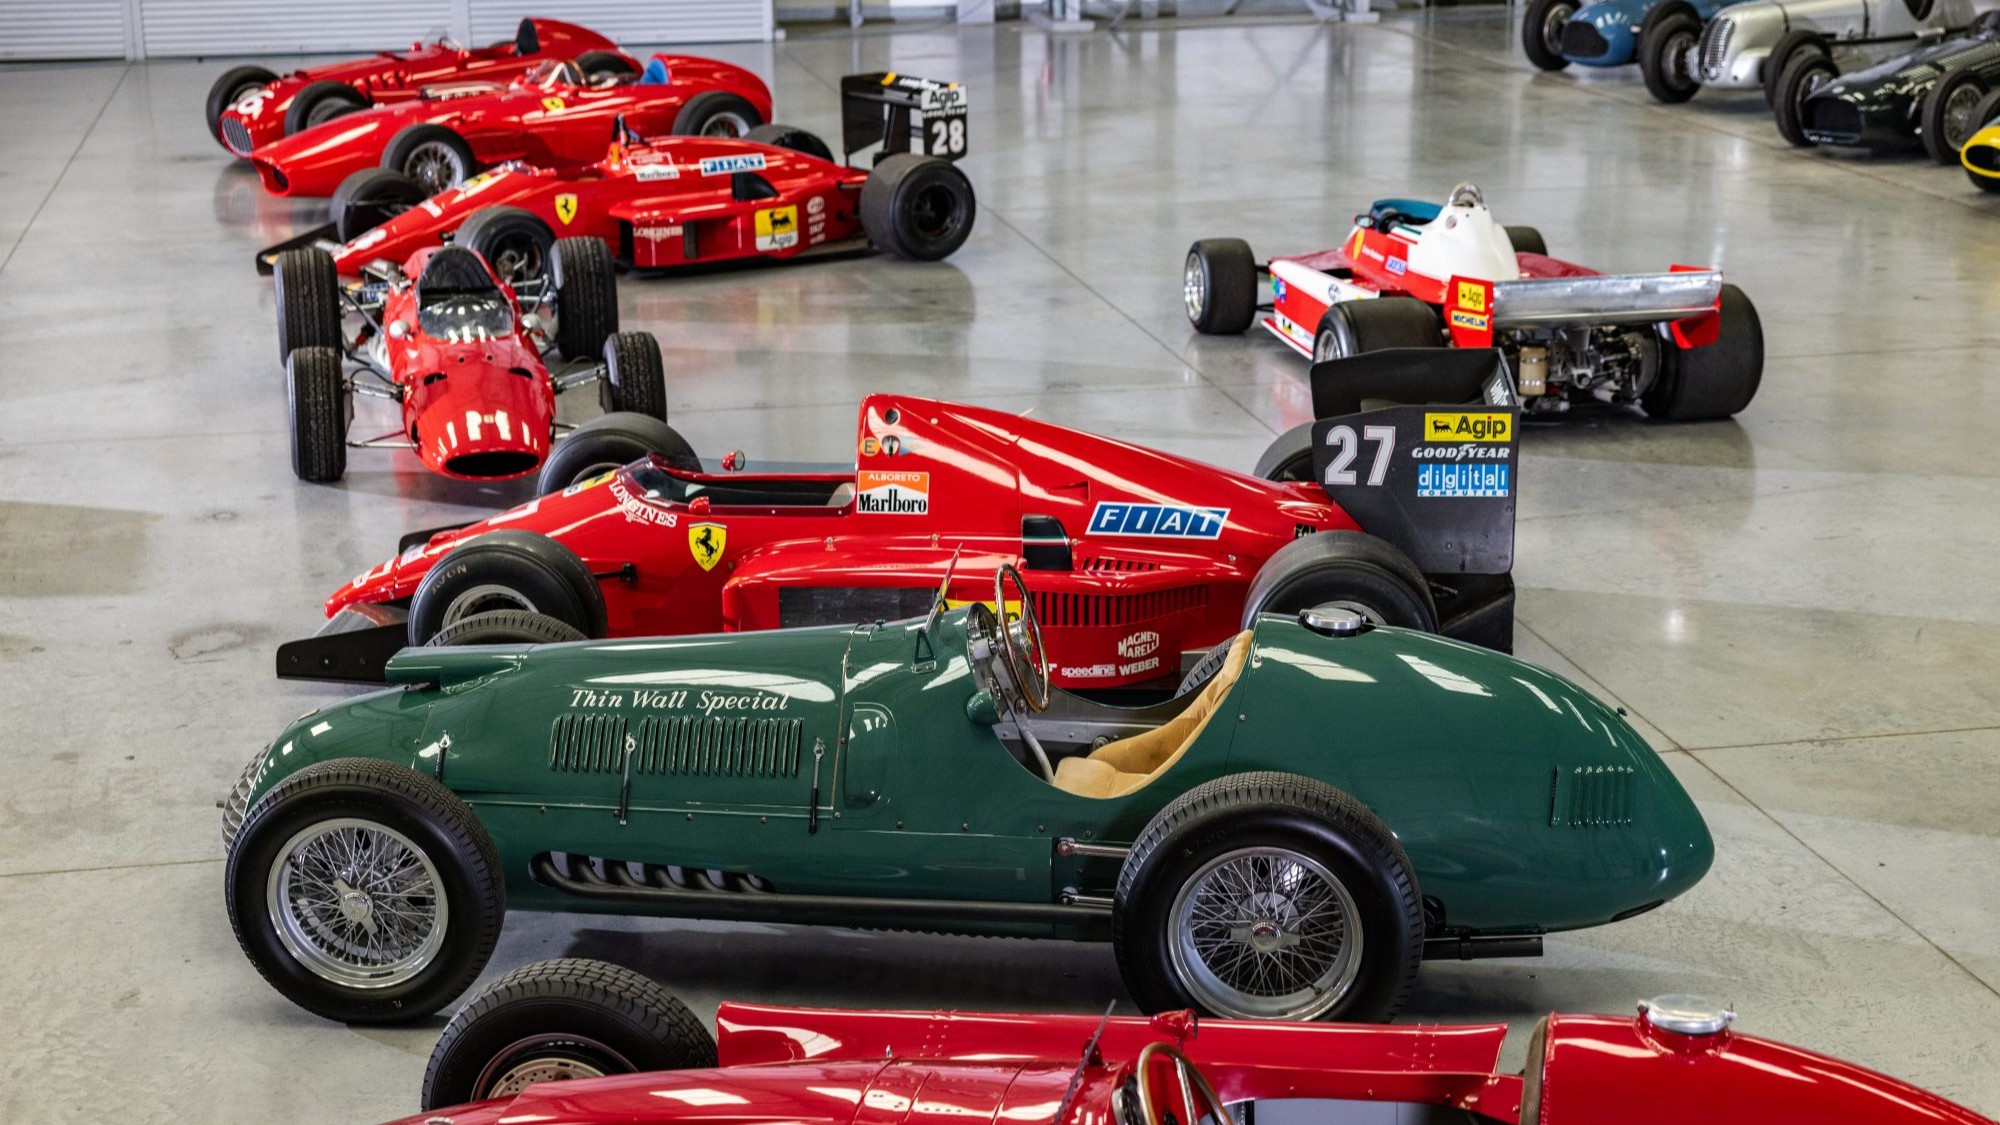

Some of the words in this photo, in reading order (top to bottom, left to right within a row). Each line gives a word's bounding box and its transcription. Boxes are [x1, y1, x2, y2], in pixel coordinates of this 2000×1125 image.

[930, 89, 959, 107] Agip
[931, 119, 964, 156] 28
[703, 157, 764, 173] FIAT
[1453, 313, 1486, 327] MICHELIN
[1455, 415, 1507, 439] Agip
[864, 439, 876, 454] E
[1324, 424, 1396, 486] 27
[1412, 445, 1510, 460] GOODYEAR
[868, 473, 921, 482] ALBORETO
[1418, 470, 1506, 488] digital
[608, 474, 678, 528] LONGINES
[858, 488, 927, 513] Marlboro
[1098, 508, 1221, 533] FIAT
[430, 563, 467, 595] AVON
[1118, 631, 1160, 650] MAGNETI
[1118, 641, 1160, 658] MARELLI
[1061, 664, 1115, 678] speedline
[1118, 656, 1160, 676] WEBER
[569, 689, 622, 708] Thin
[632, 690, 686, 709] Wall
[696, 690, 791, 716] Special
